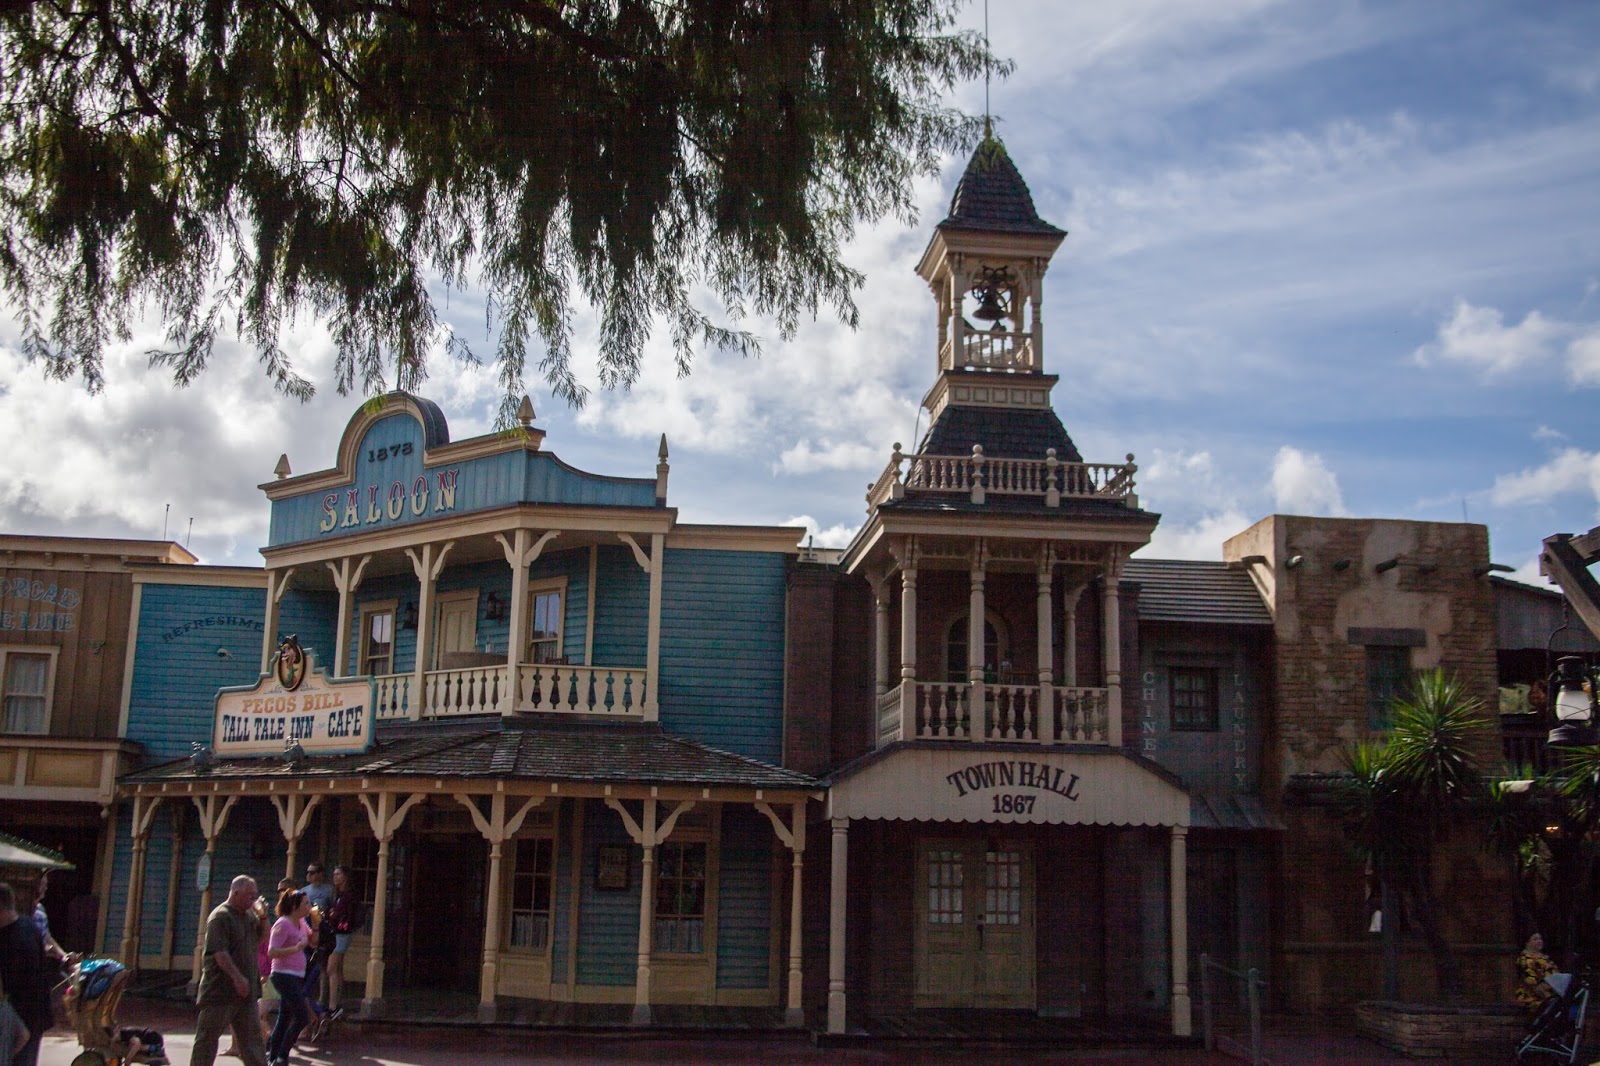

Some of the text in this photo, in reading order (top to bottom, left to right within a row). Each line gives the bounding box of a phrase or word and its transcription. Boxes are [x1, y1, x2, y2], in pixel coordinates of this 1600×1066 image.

[319, 469, 460, 534] SALOON
[19, 611, 75, 632] LINE
[242, 692, 344, 714] PECOS BILL
[222, 705, 364, 742] TALL TALE INN CAFE
[1233, 673, 1246, 786] LAUNDRY
[945, 761, 1080, 802] TOWN HALL
[992, 794, 1037, 814] 1867
